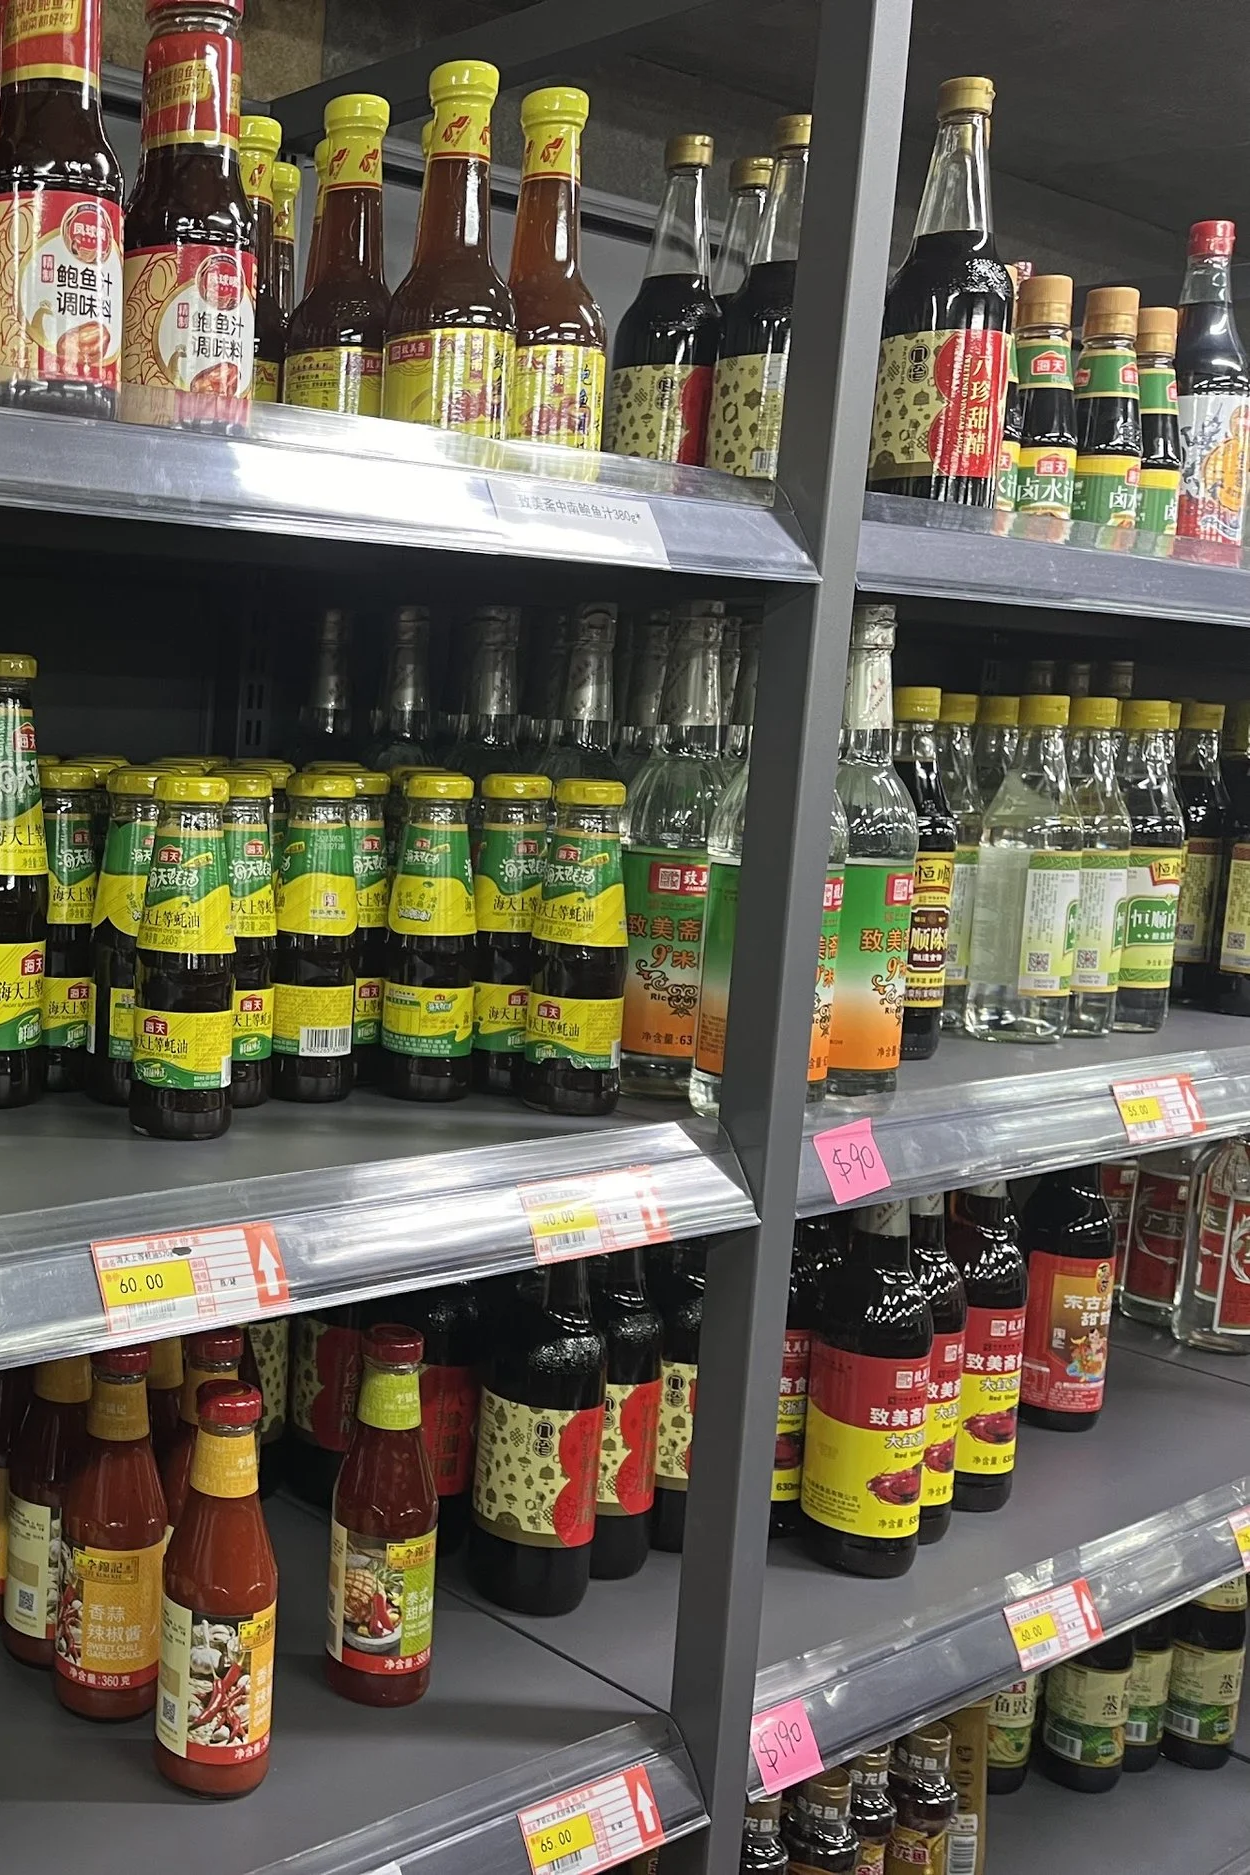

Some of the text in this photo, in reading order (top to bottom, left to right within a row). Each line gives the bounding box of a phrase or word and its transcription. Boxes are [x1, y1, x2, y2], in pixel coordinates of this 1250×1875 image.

[56, 264, 112, 294] 鲍鱼汁
[56, 291, 112, 324] 调味料
[192, 312, 245, 336] 鲍鱼汁
[191, 335, 244, 360] 调味料
[968, 355, 992, 456] 八珍甜醋
[628, 916, 703, 941] 致美斋
[831, 1142, 876, 1185] $90
[542, 1209, 575, 1227] 40.00
[120, 1273, 164, 1294] 60.00
[88, 1604, 126, 1623] 香蒜
[1020, 1624, 1043, 1642] 60.00
[756, 1720, 803, 1775] $190
[540, 1829, 573, 1855] 65.00
